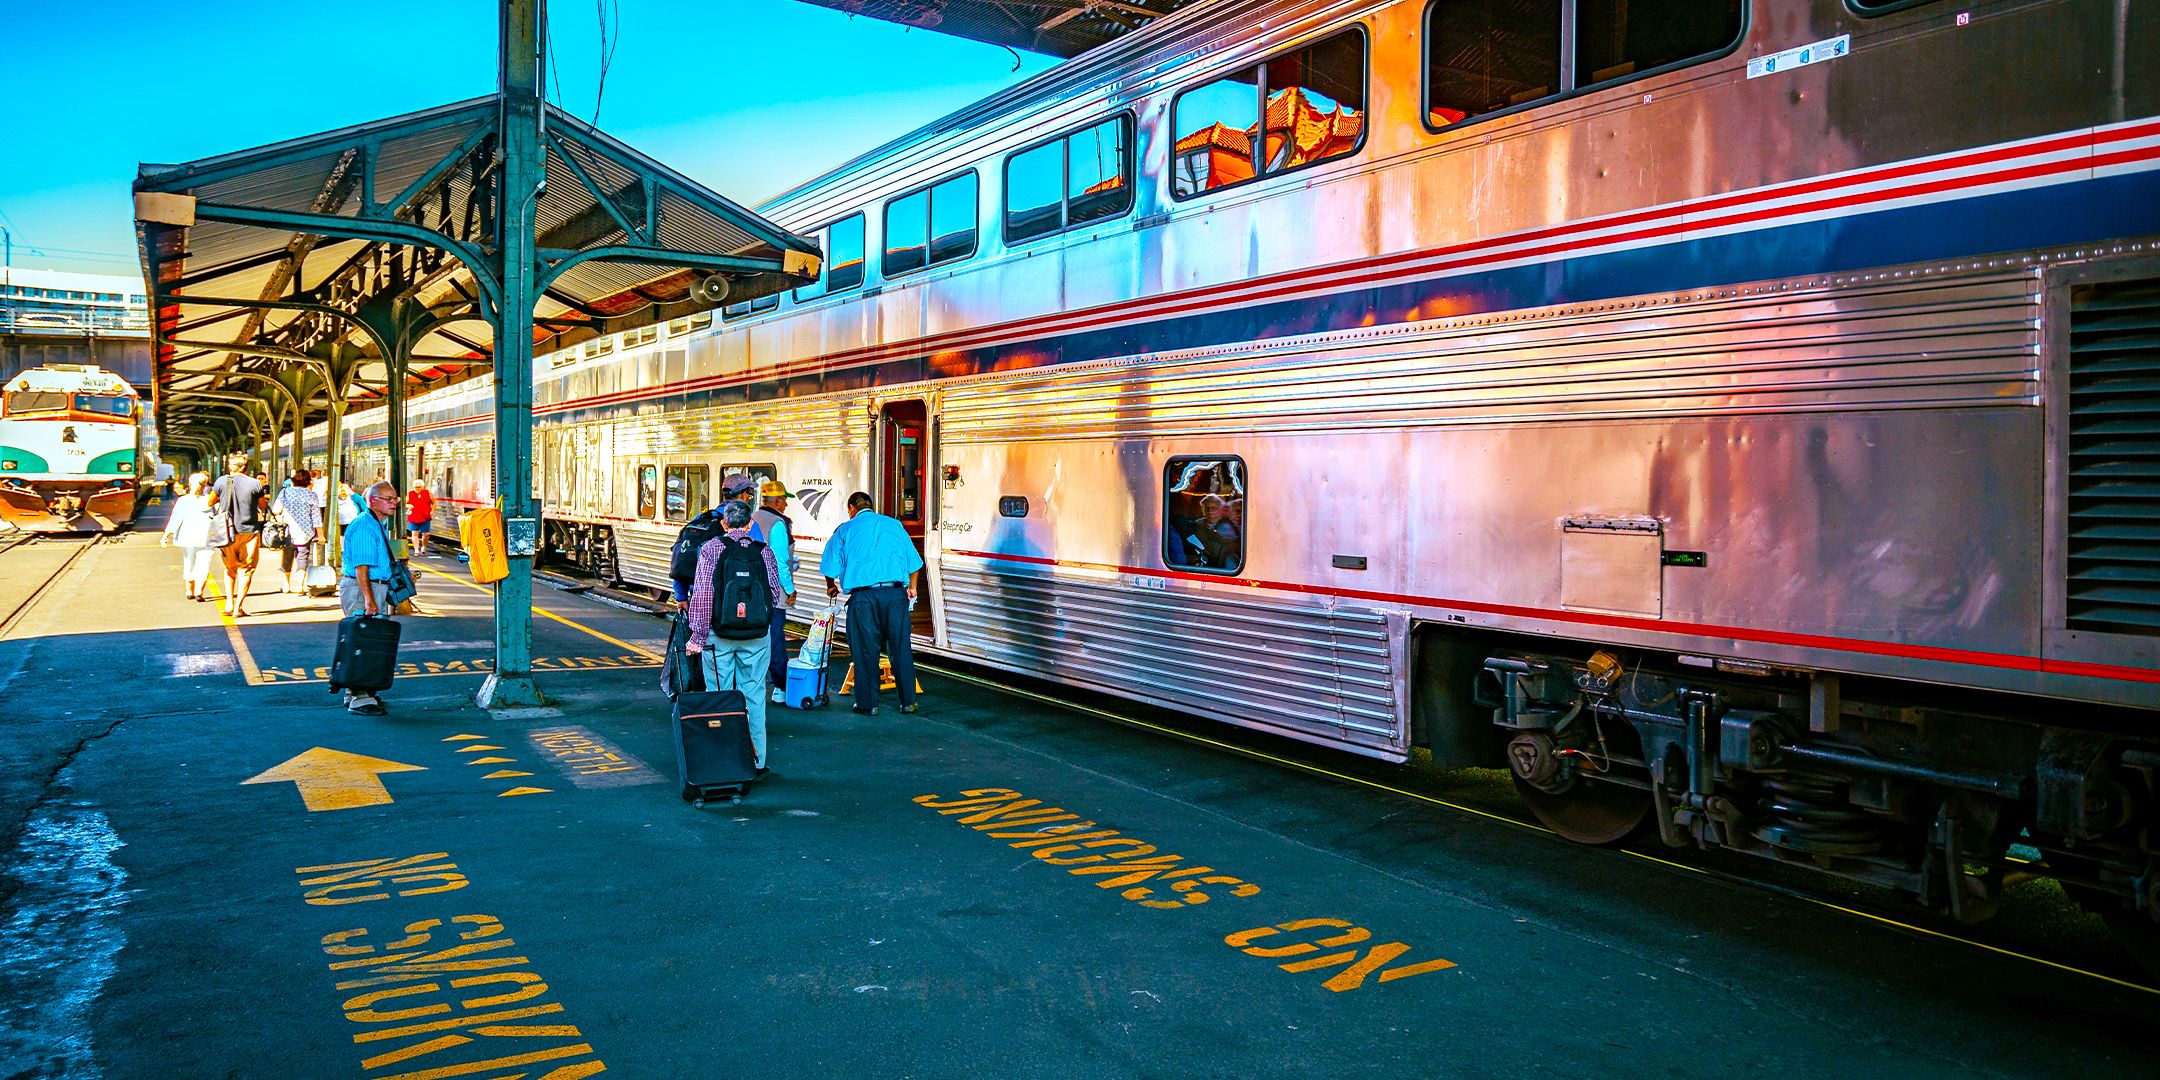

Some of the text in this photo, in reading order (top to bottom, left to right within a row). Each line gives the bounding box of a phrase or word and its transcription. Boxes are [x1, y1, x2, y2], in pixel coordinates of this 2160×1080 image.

[801, 478, 833, 486] AMTRAK
[942, 520, 973, 534] Sleeping Car
[528, 731, 638, 775] NORTH
[911, 787, 1458, 993] NO SMOKING
[295, 852, 608, 1080] NO SMOKI
